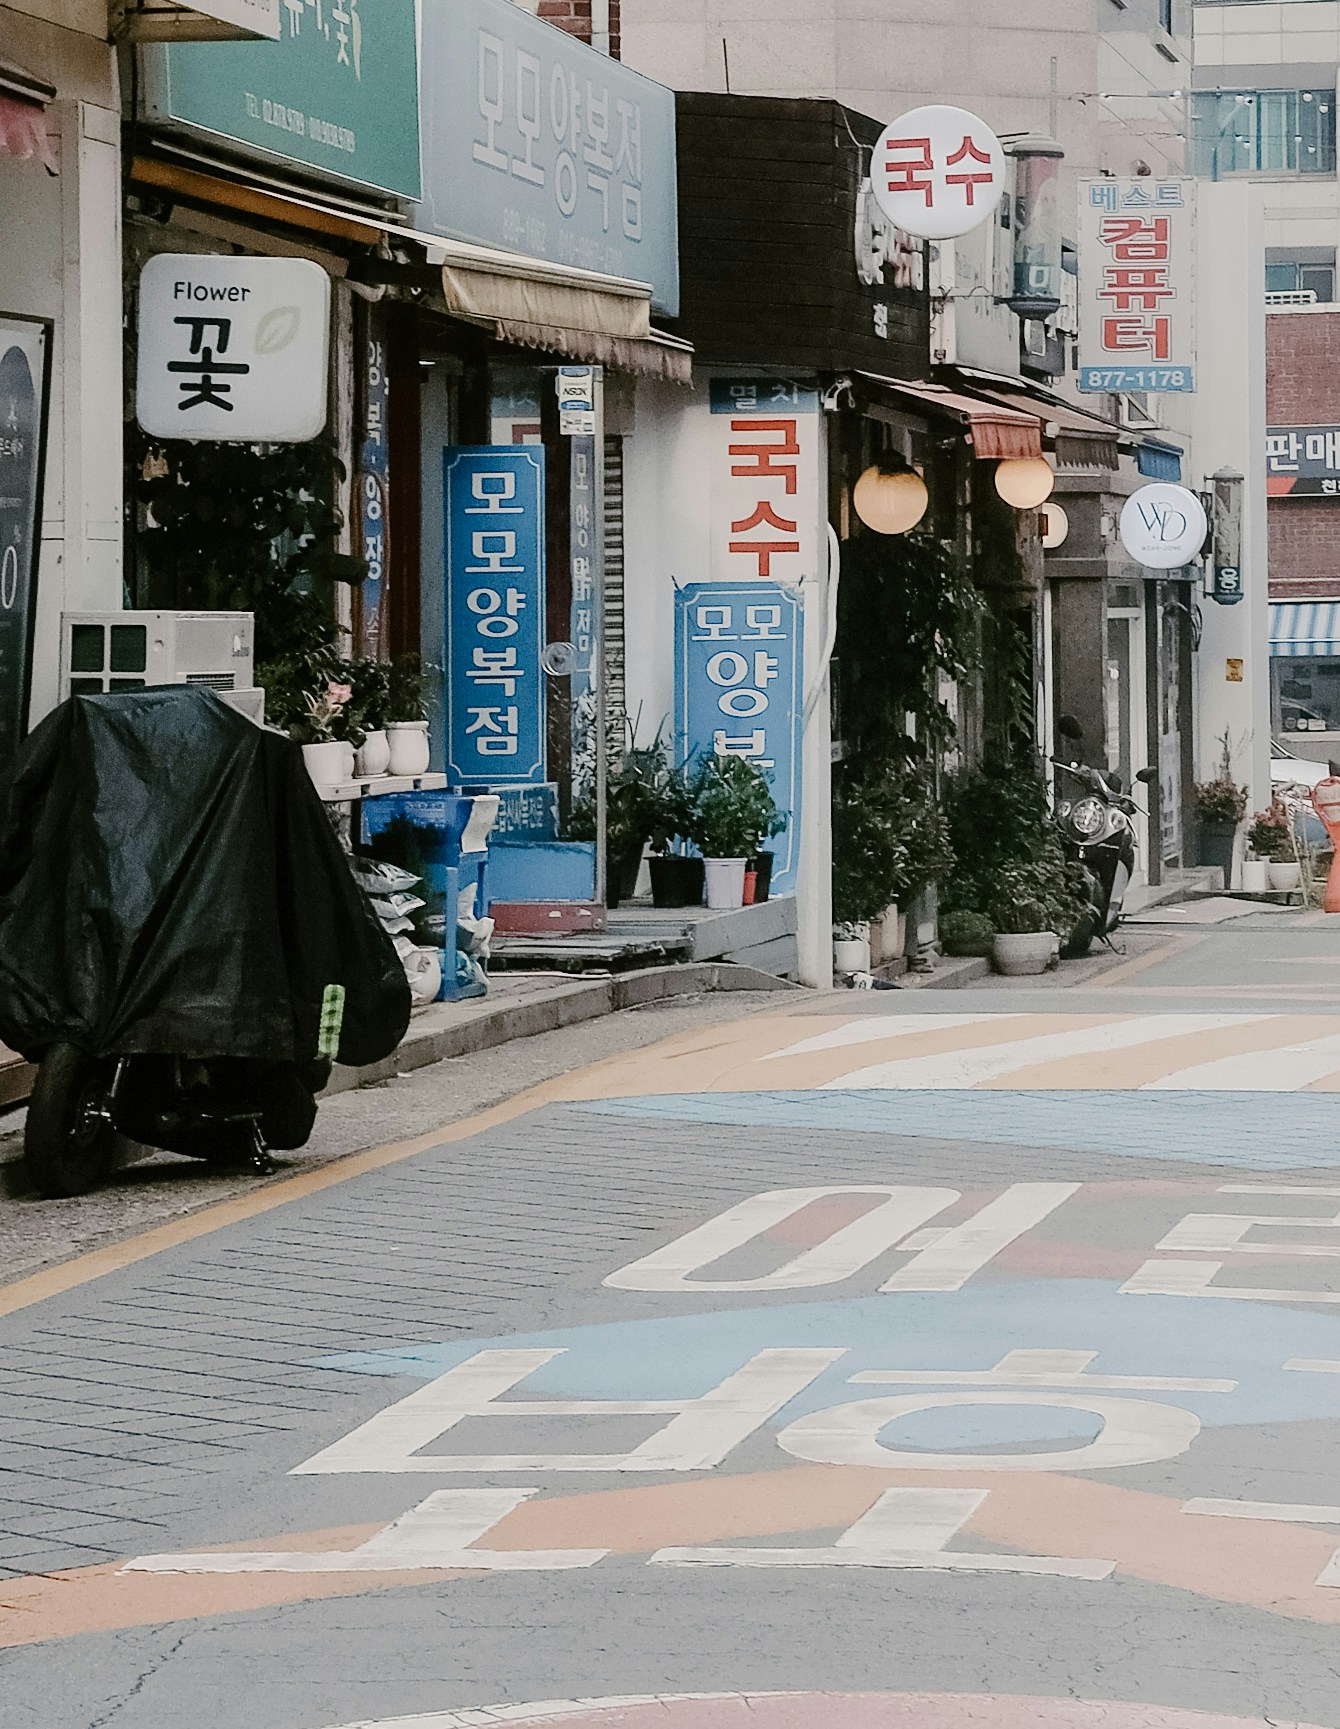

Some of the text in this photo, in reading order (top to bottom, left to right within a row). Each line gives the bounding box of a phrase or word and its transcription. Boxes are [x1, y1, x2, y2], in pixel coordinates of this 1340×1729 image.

[472, 26, 642, 243] 모모양복점
[884, 135, 993, 208] 국수
[1087, 183, 1185, 212] 베스트
[173, 281, 251, 305] Flower
[1096, 213, 1174, 363] 컴퓨터
[167, 315, 251, 412] 꽃
[730, 384, 799, 410] 멸치
[1087, 369, 1186, 388] 877-1178
[728, 418, 801, 577] 국수
[464, 470, 528, 758] 모모양복점
[691, 604, 788, 642] 모모
